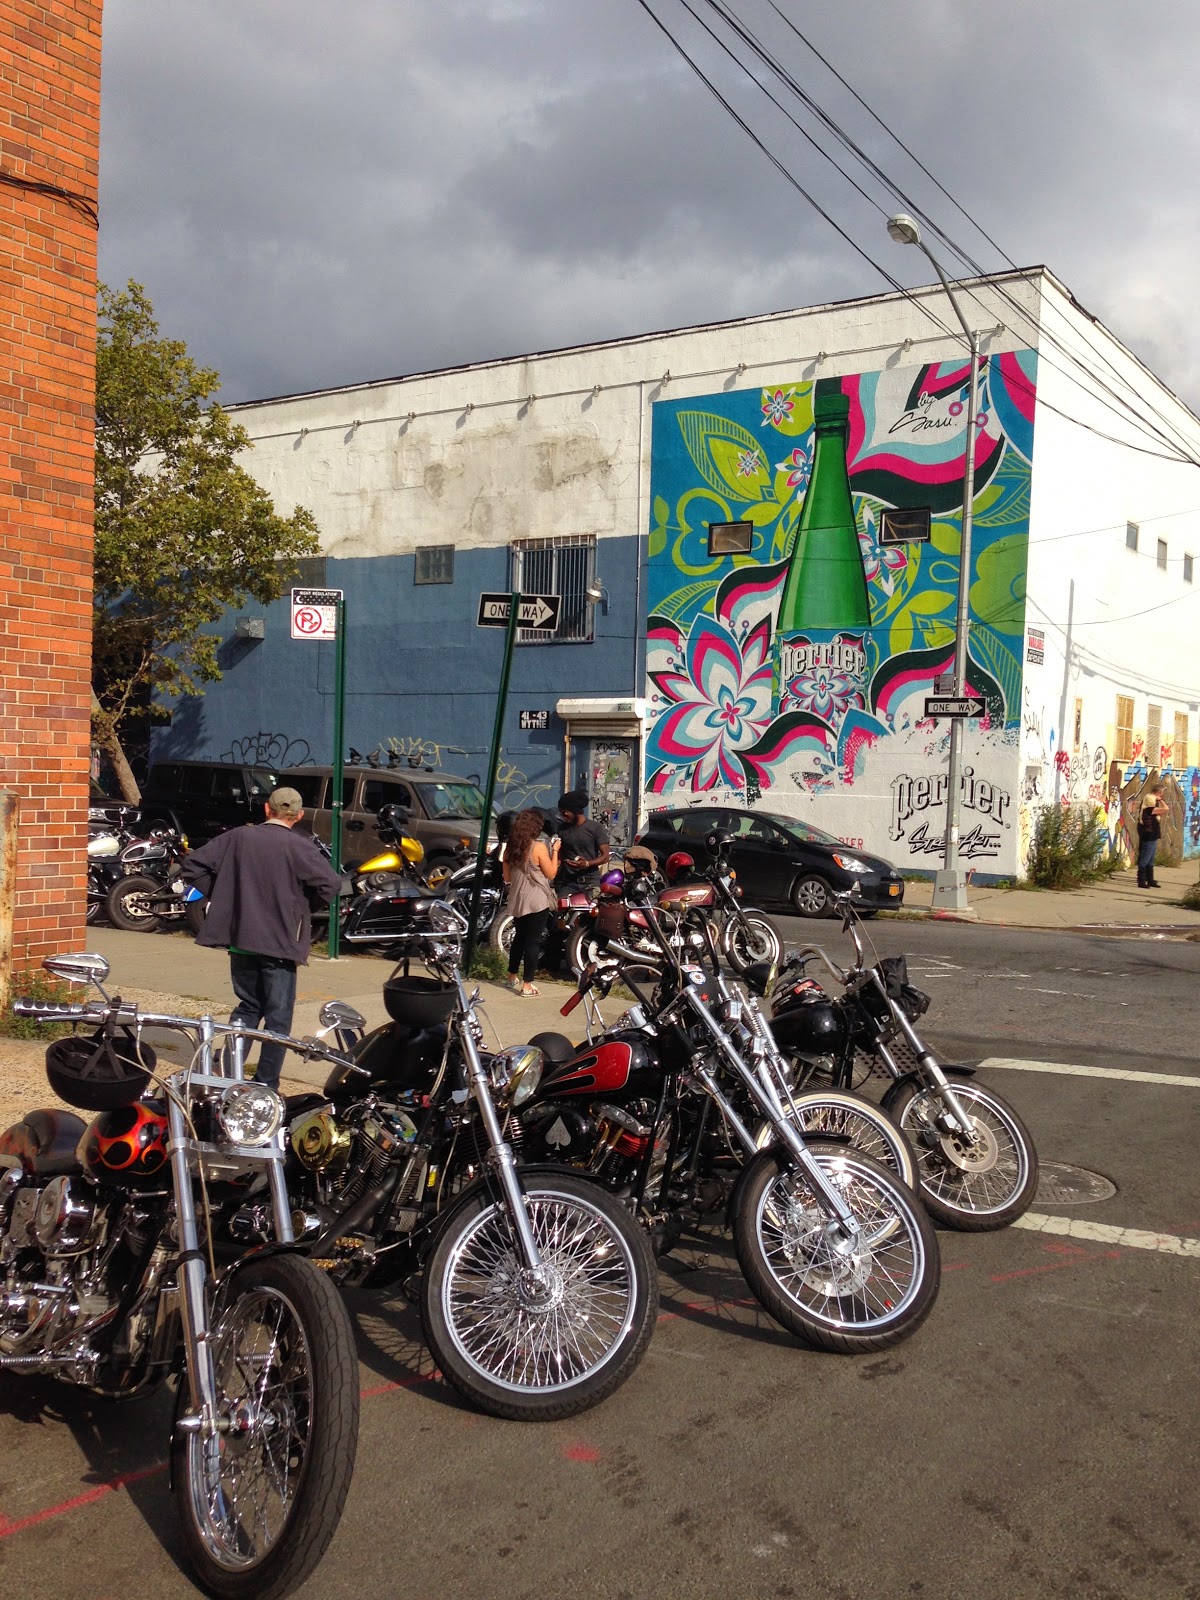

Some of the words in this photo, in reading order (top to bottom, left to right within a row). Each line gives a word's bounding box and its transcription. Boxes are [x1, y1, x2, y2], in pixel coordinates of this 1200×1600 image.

[920, 392, 936, 414] by
[490, 604, 512, 617] ONE
[522, 605, 546, 619] WAY
[932, 703, 951, 712] ONE
[957, 703, 977, 712] WAY
[521, 719, 547, 729] WYTHE
